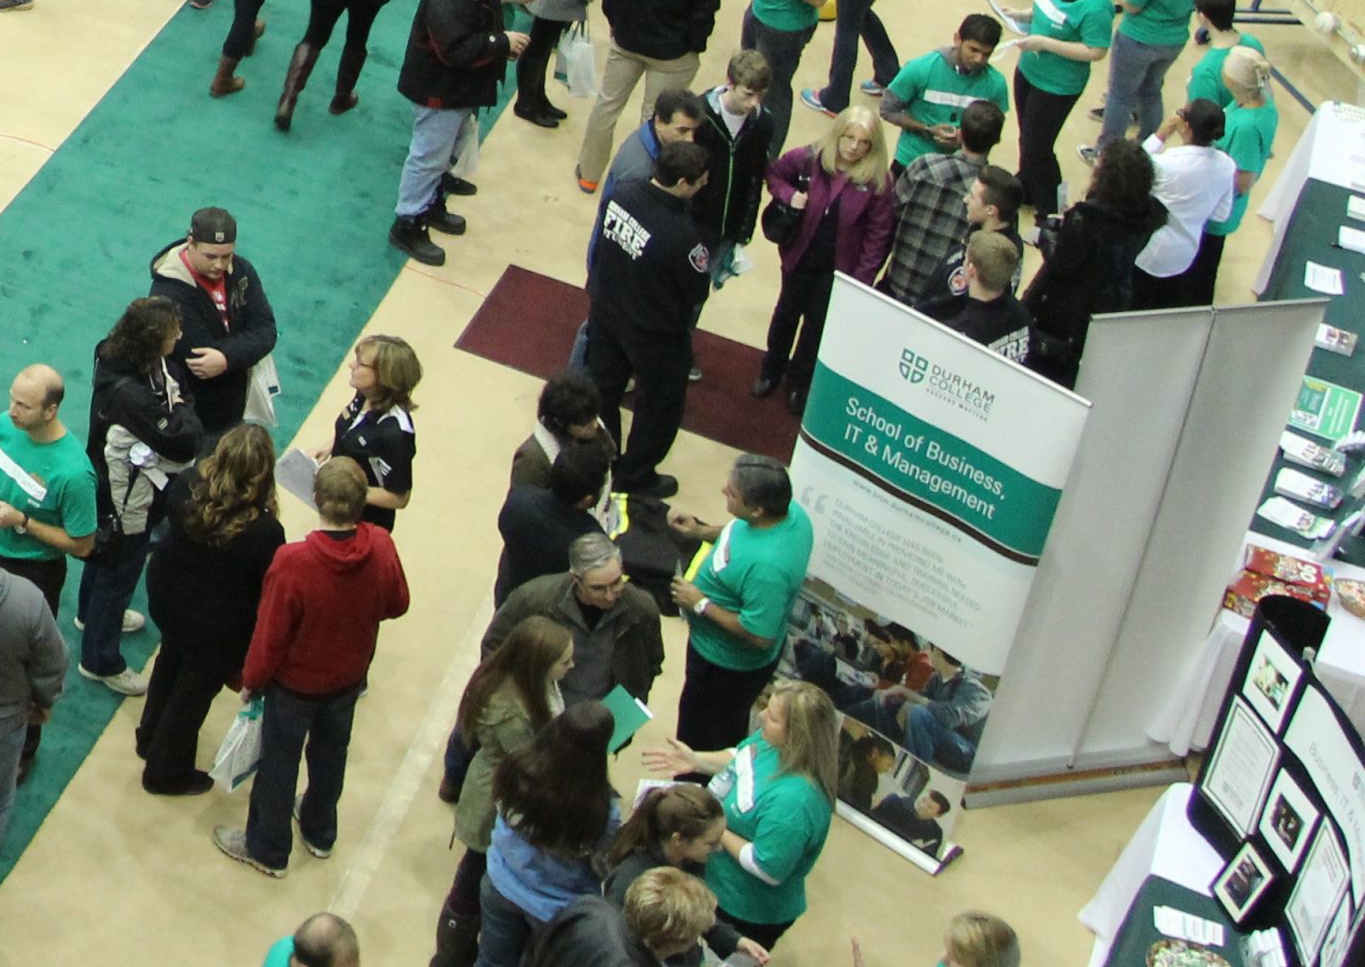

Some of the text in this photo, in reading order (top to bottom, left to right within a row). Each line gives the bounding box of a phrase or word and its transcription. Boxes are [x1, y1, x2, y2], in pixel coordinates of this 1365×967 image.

[603, 209, 647, 257] FIRE
[929, 375, 992, 414] COLLEGE
[931, 364, 996, 404] DURHAM
[844, 423, 996, 520] IT & Management
[846, 396, 1007, 501] School of Business,
